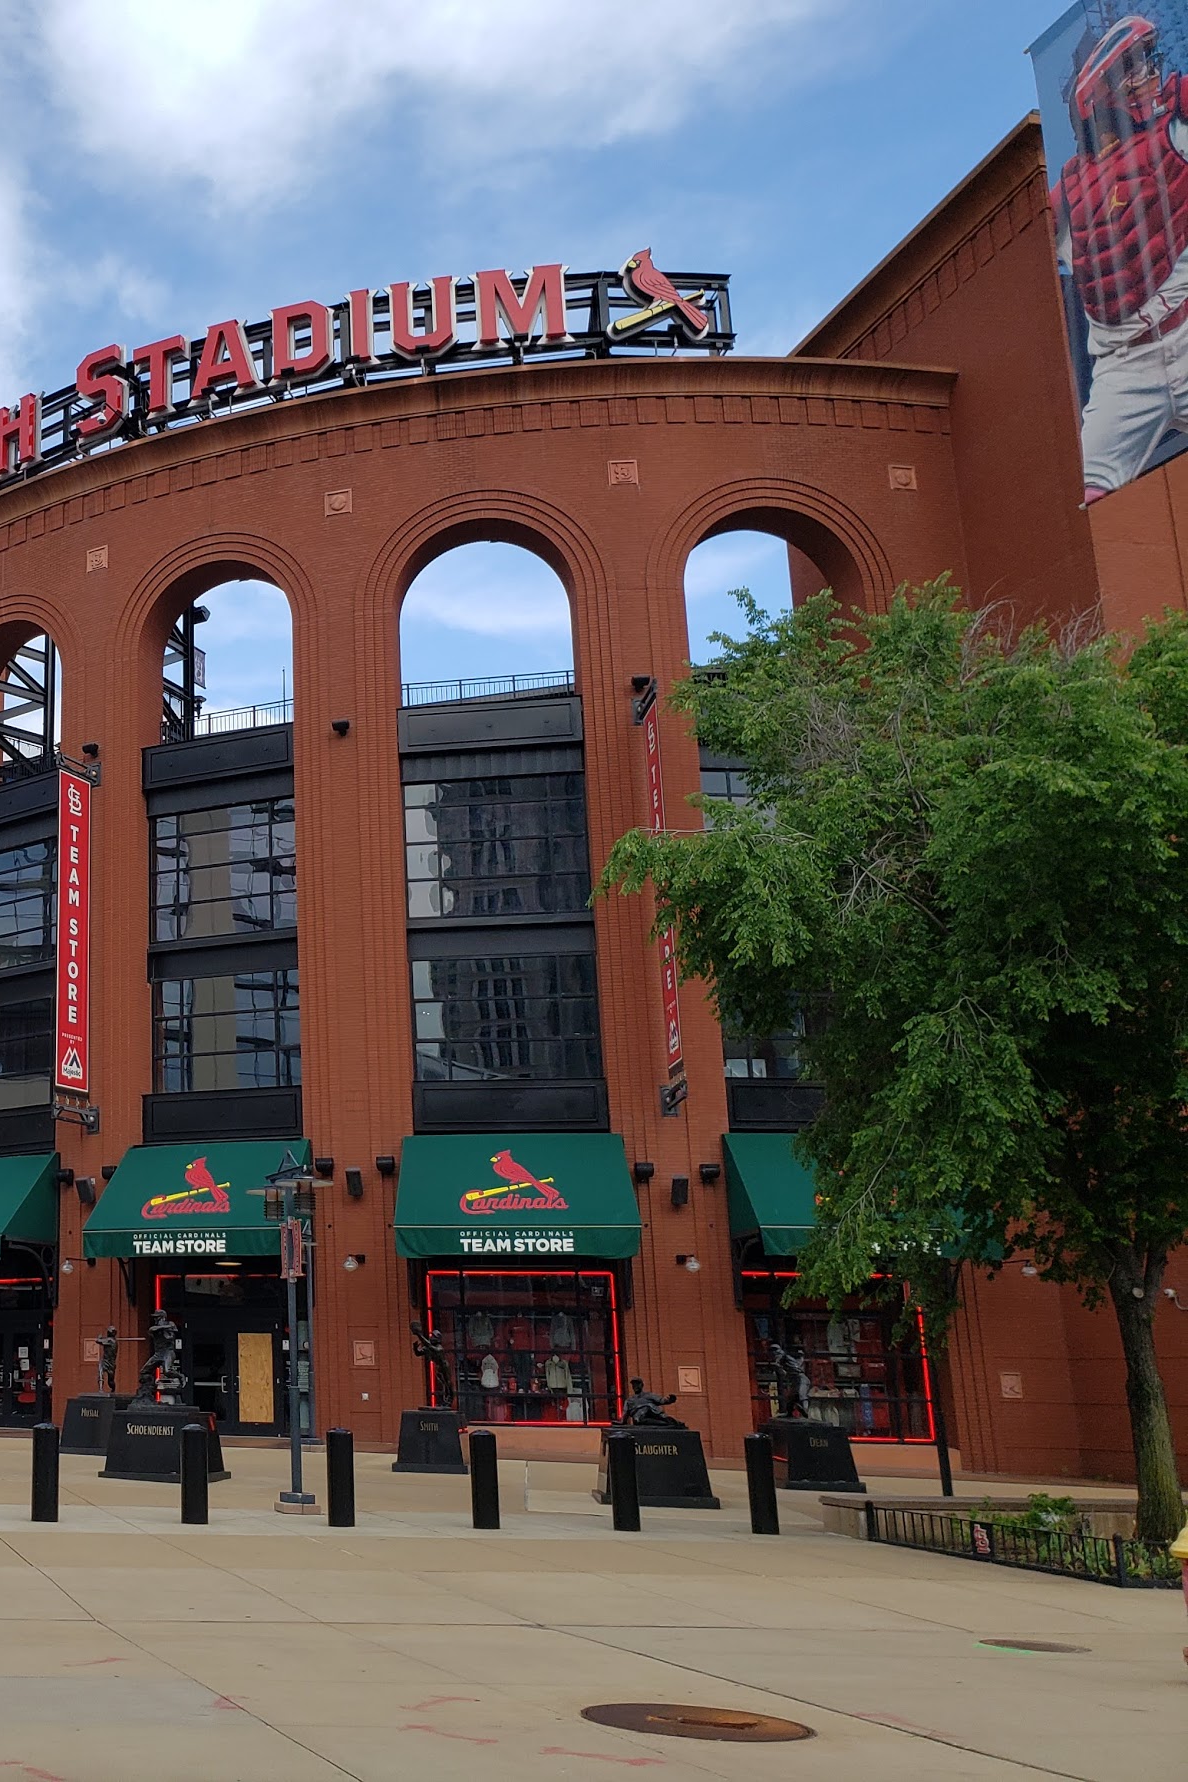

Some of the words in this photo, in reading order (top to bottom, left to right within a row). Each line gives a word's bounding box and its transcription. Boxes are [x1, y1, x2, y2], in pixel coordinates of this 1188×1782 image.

[74, 262, 575, 440] STADIUM
[68, 825, 80, 907] TEAM
[67, 919, 80, 1024] STORE
[63, 1066, 81, 1079] Majestic
[141, 1195, 231, 1220] Cardinals
[459, 1189, 569, 1215] Cardinals
[133, 1241, 174, 1254] TEAM
[176, 1240, 227, 1253] STORE
[460, 1238, 511, 1252] TEAM
[514, 1238, 574, 1252] STORE
